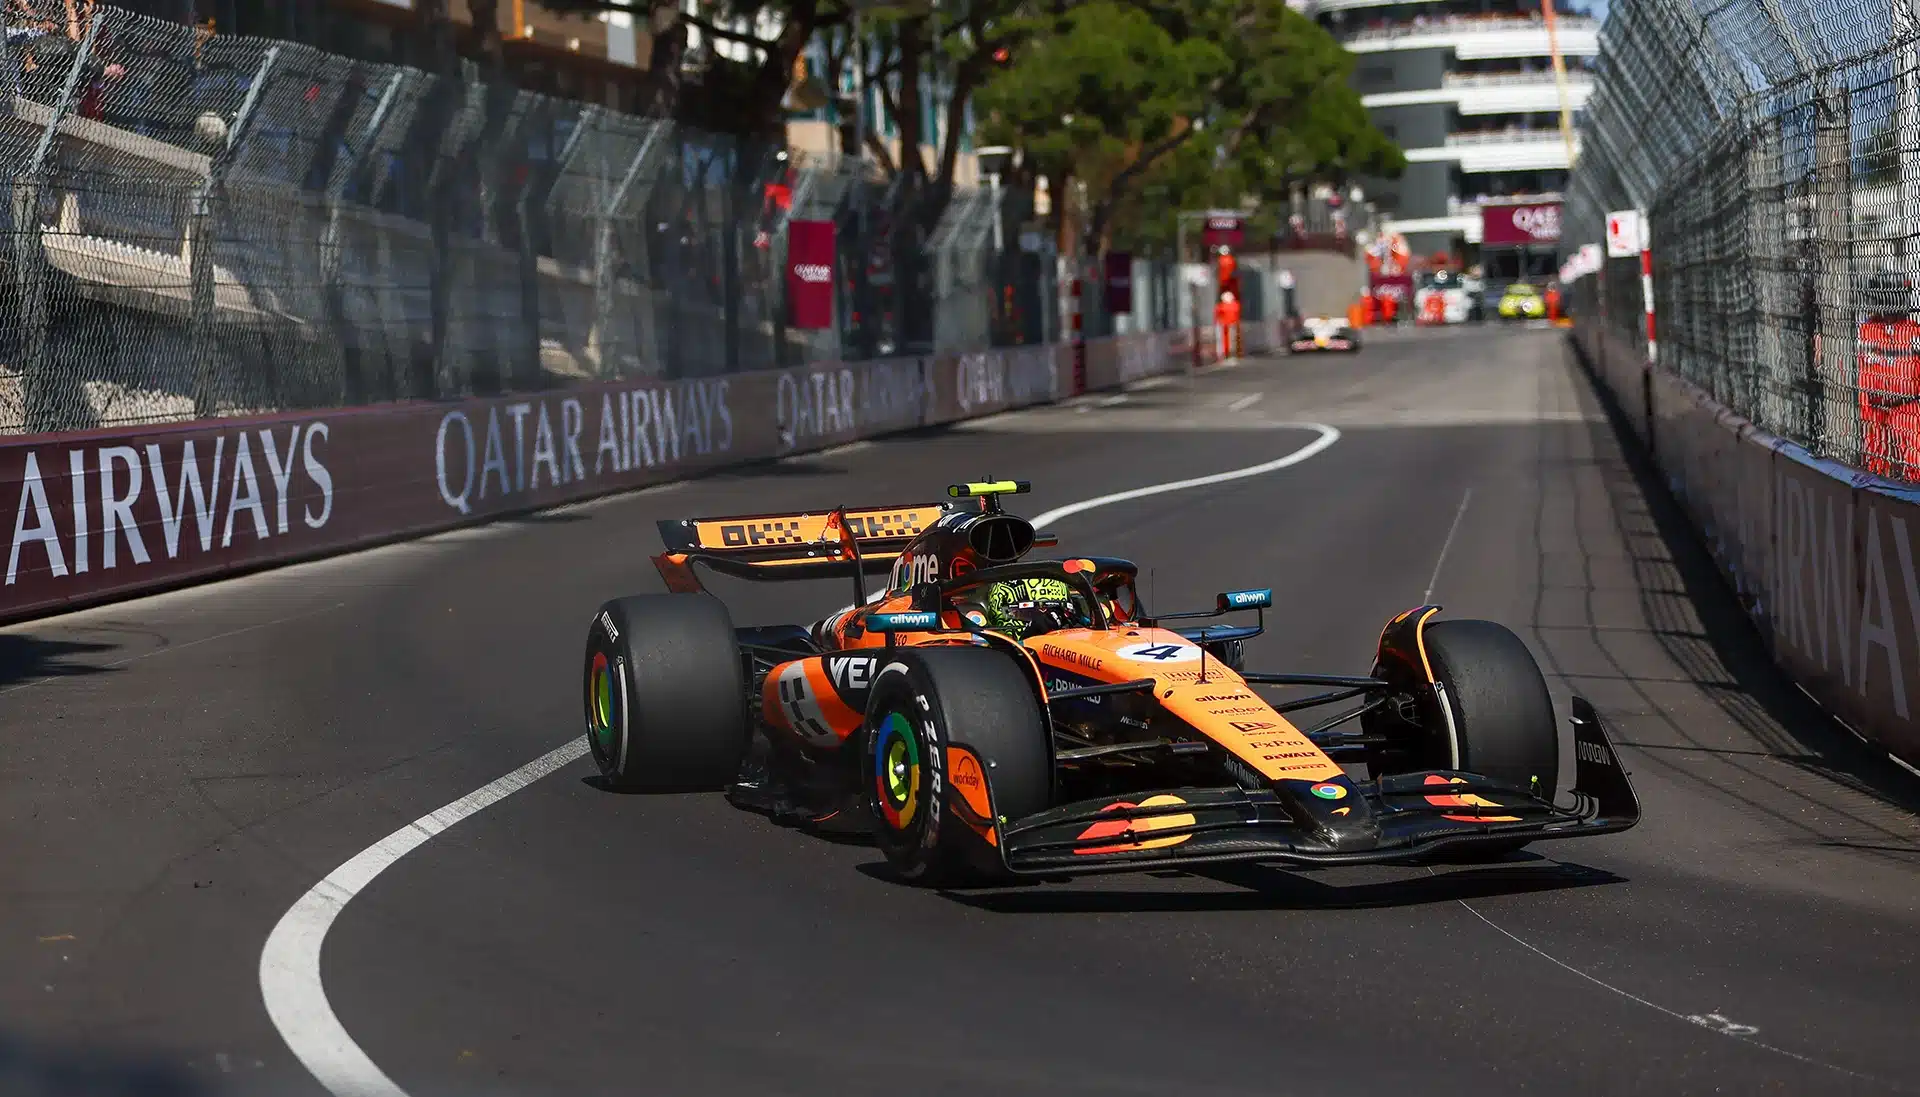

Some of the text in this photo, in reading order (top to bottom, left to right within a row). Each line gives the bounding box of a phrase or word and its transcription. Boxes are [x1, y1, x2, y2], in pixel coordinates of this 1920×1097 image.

[777, 369, 854, 448] QATAR
[436, 380, 733, 514] QATAR AIRWAYS
[5, 422, 332, 585] AIRWAYS
[721, 521, 802, 546] OKX
[1235, 592, 1266, 604] allwyn
[889, 612, 929, 625] allwyn
[1042, 643, 1103, 671] RICHARD MILLE
[1133, 645, 1183, 660] 4
[1195, 693, 1251, 703] allwyn
[1208, 706, 1266, 715] webex
[1249, 740, 1305, 749] FxPro
[916, 694, 942, 822] P ZERO
[953, 772, 979, 790] workday
